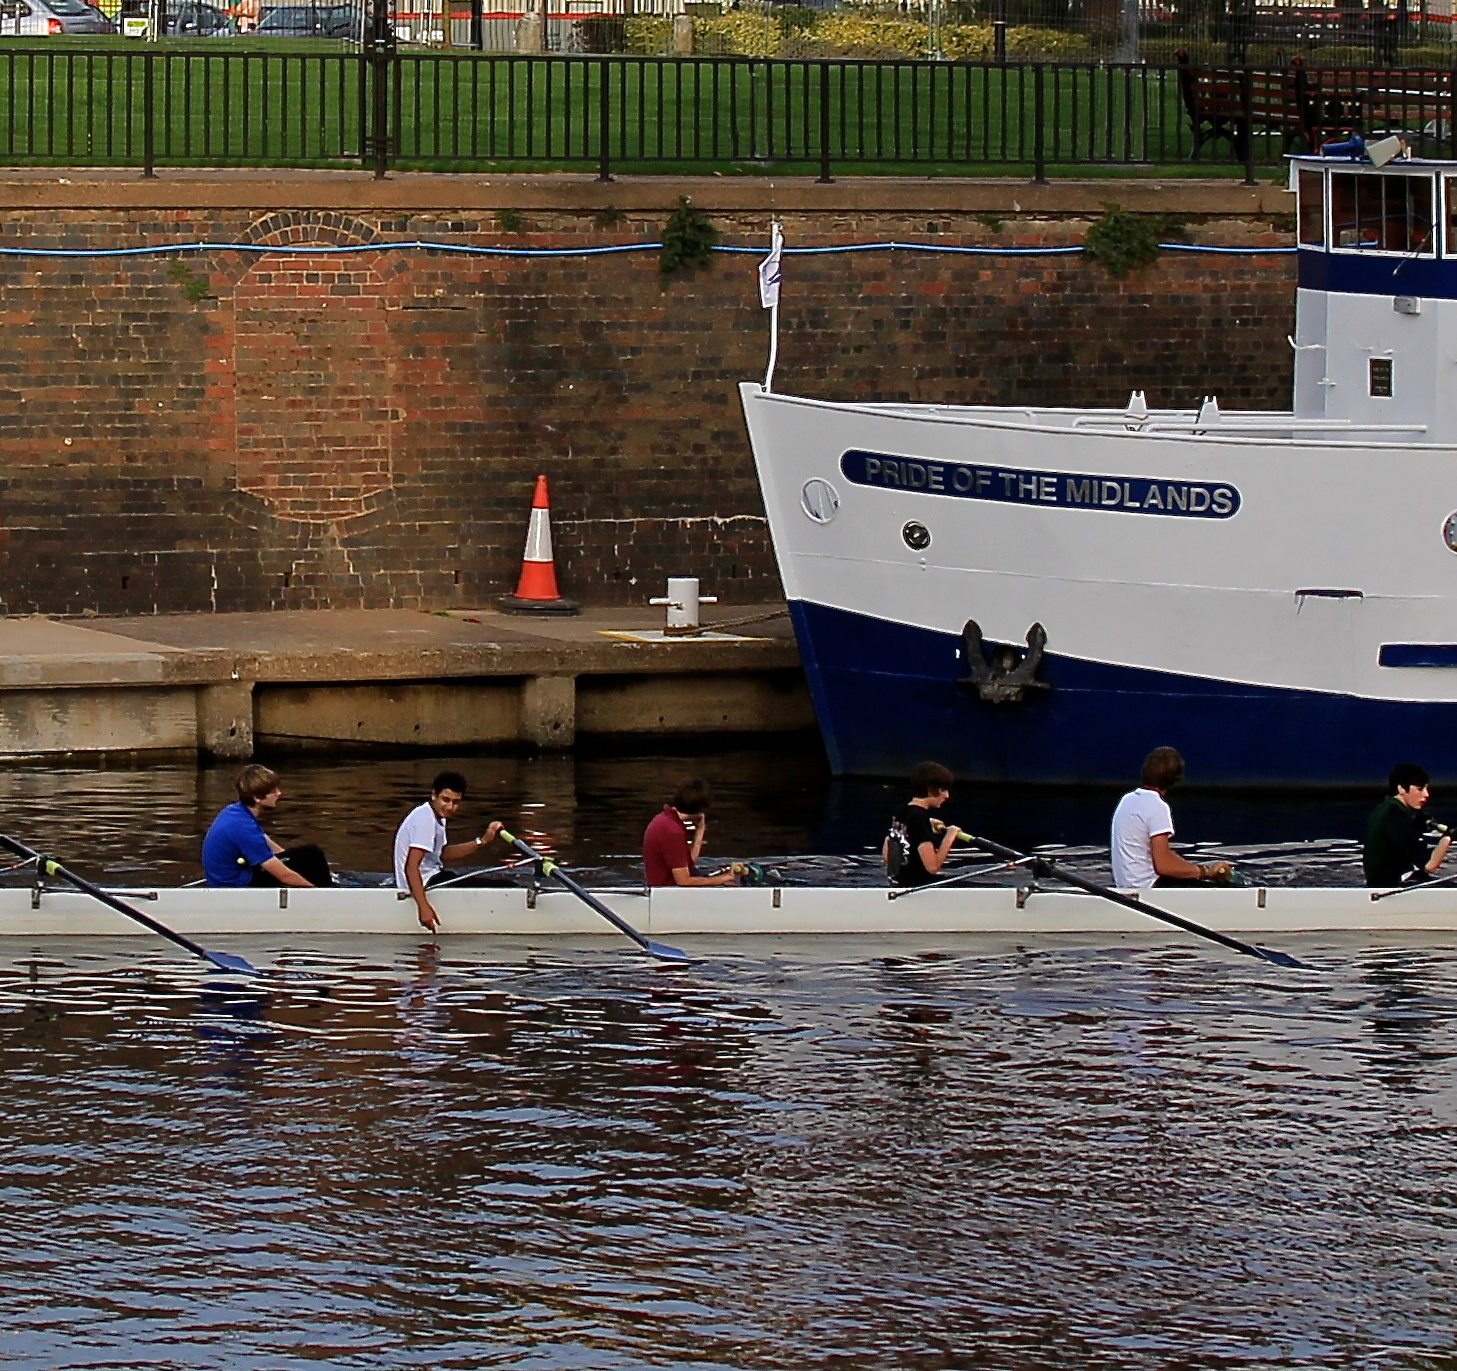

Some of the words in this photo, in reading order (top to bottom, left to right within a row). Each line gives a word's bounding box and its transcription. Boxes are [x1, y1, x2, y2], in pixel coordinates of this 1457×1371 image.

[864, 456, 944, 491] PRIDE
[951, 465, 993, 494] OF
[998, 472, 1058, 502] THE
[1065, 478, 1234, 515] MIDLANDS
